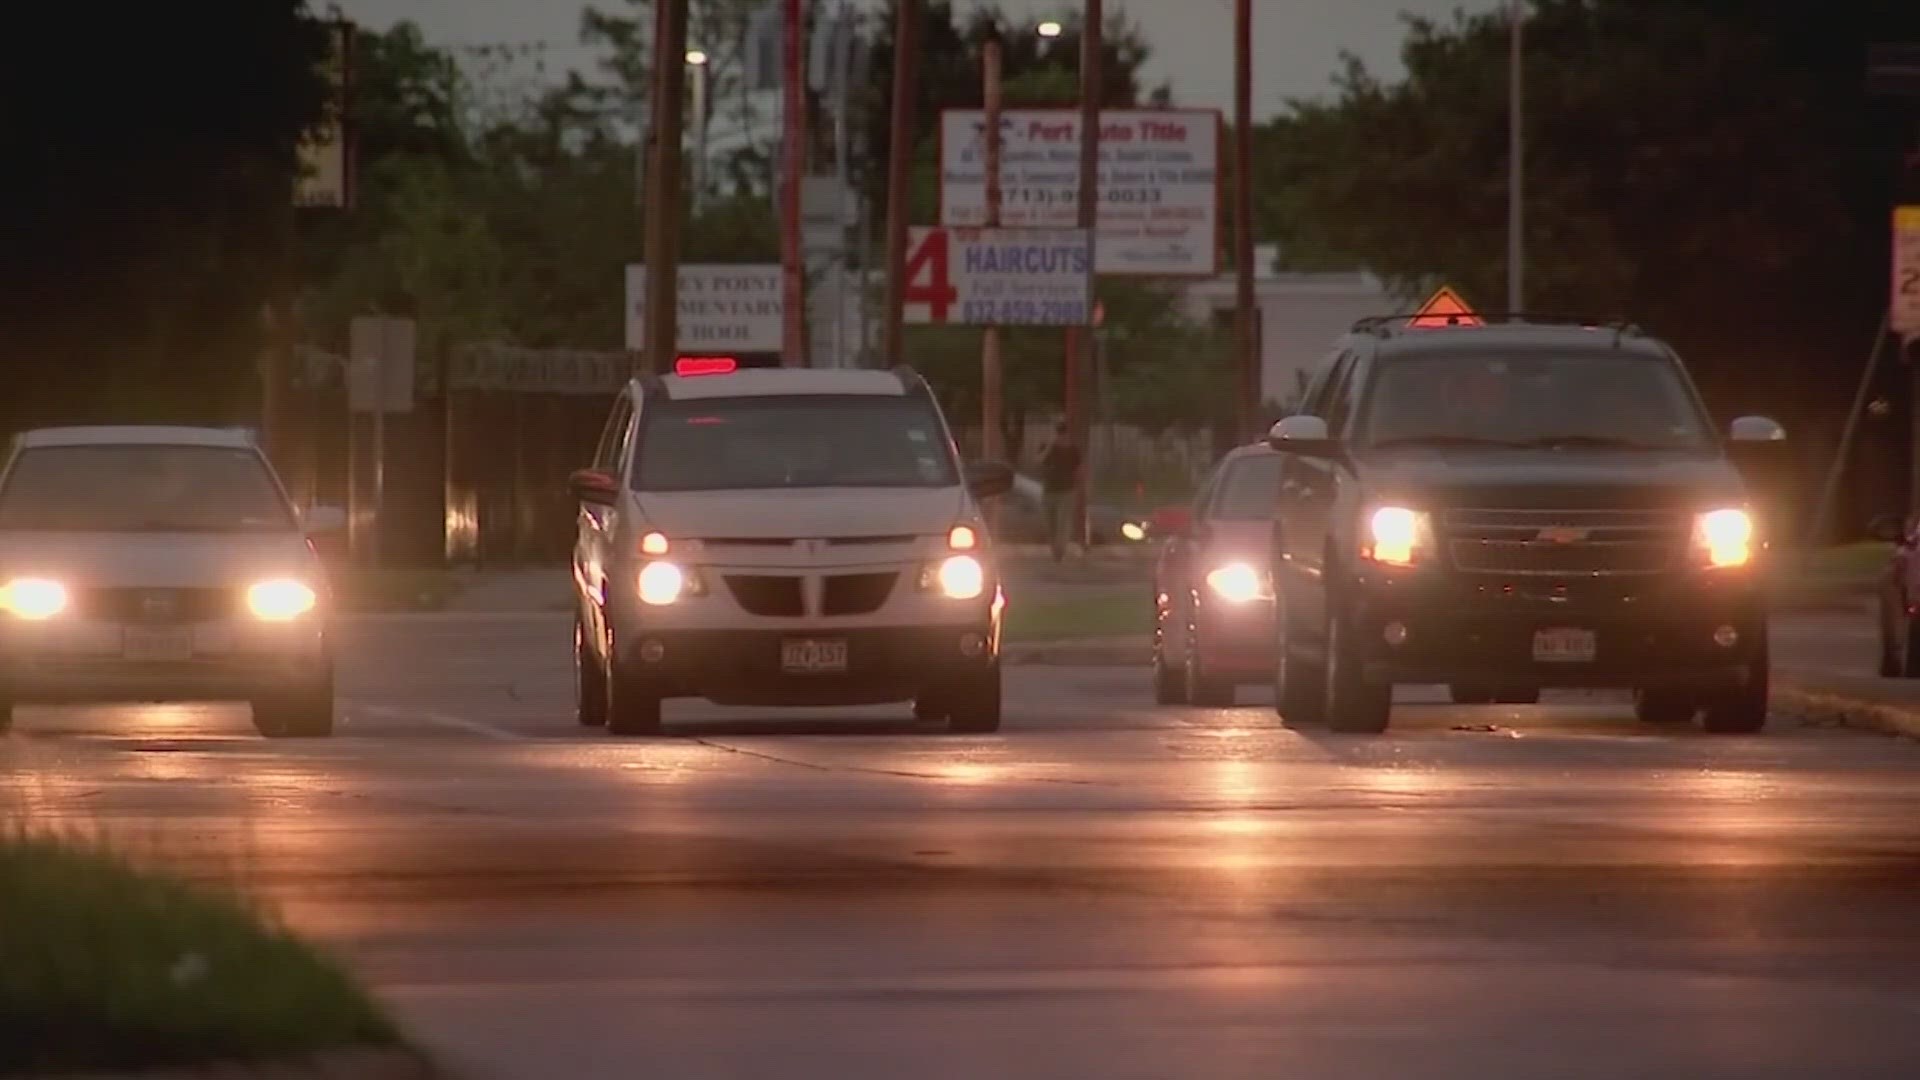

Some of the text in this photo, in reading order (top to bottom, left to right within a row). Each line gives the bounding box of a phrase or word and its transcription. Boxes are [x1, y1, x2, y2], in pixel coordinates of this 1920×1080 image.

[1097, 122, 1133, 142] uto
[1139, 121, 1187, 142] Title
[965, 246, 1089, 273] HAIRCUTS
